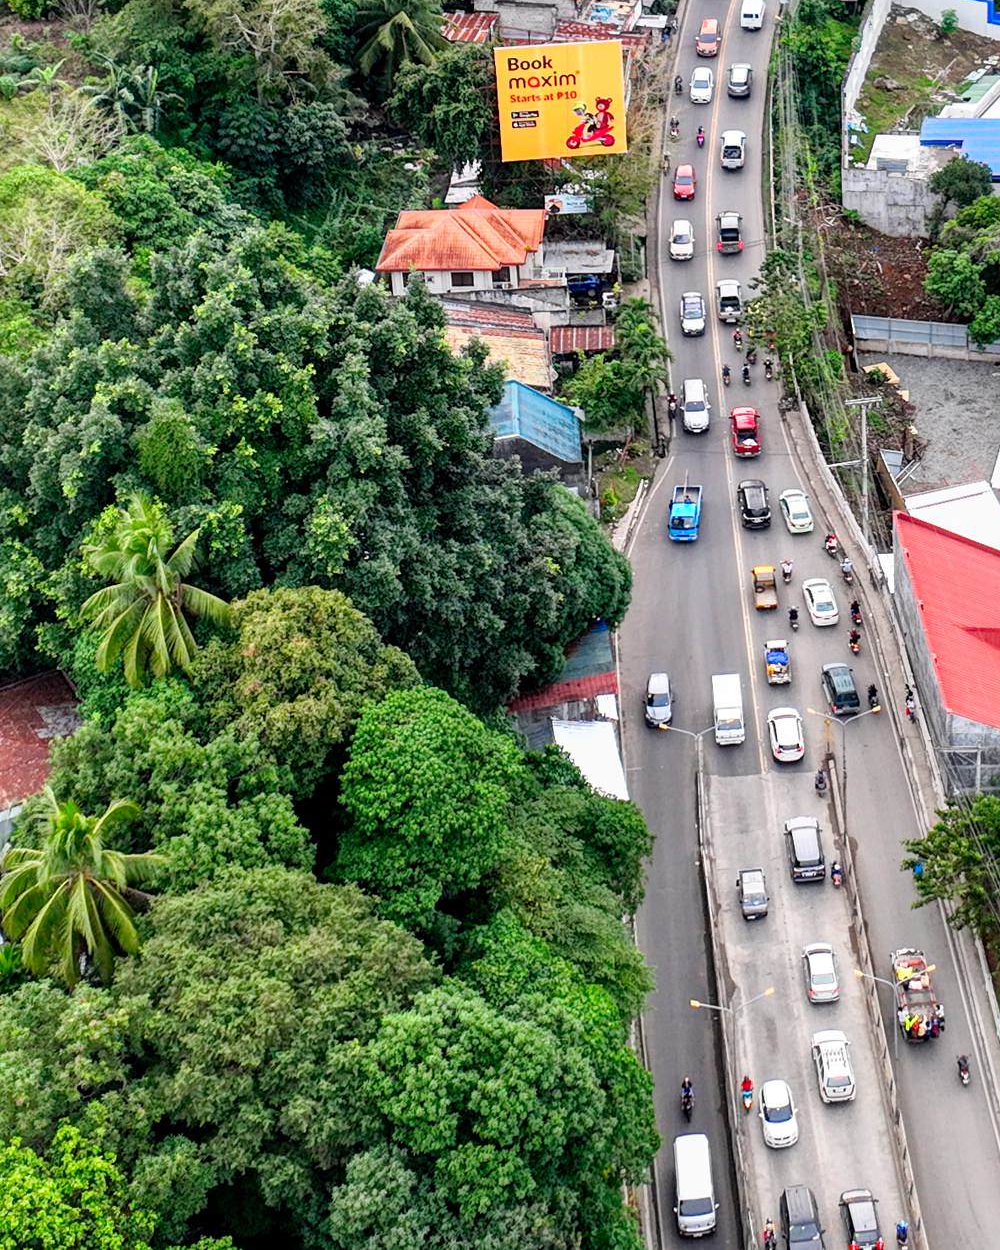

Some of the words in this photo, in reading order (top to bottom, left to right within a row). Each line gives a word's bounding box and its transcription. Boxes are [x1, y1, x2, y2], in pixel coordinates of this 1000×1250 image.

[507, 55, 553, 71] Book
[509, 71, 577, 89] maxim
[510, 94, 541, 103] Starts
[543, 93, 554, 101] at
